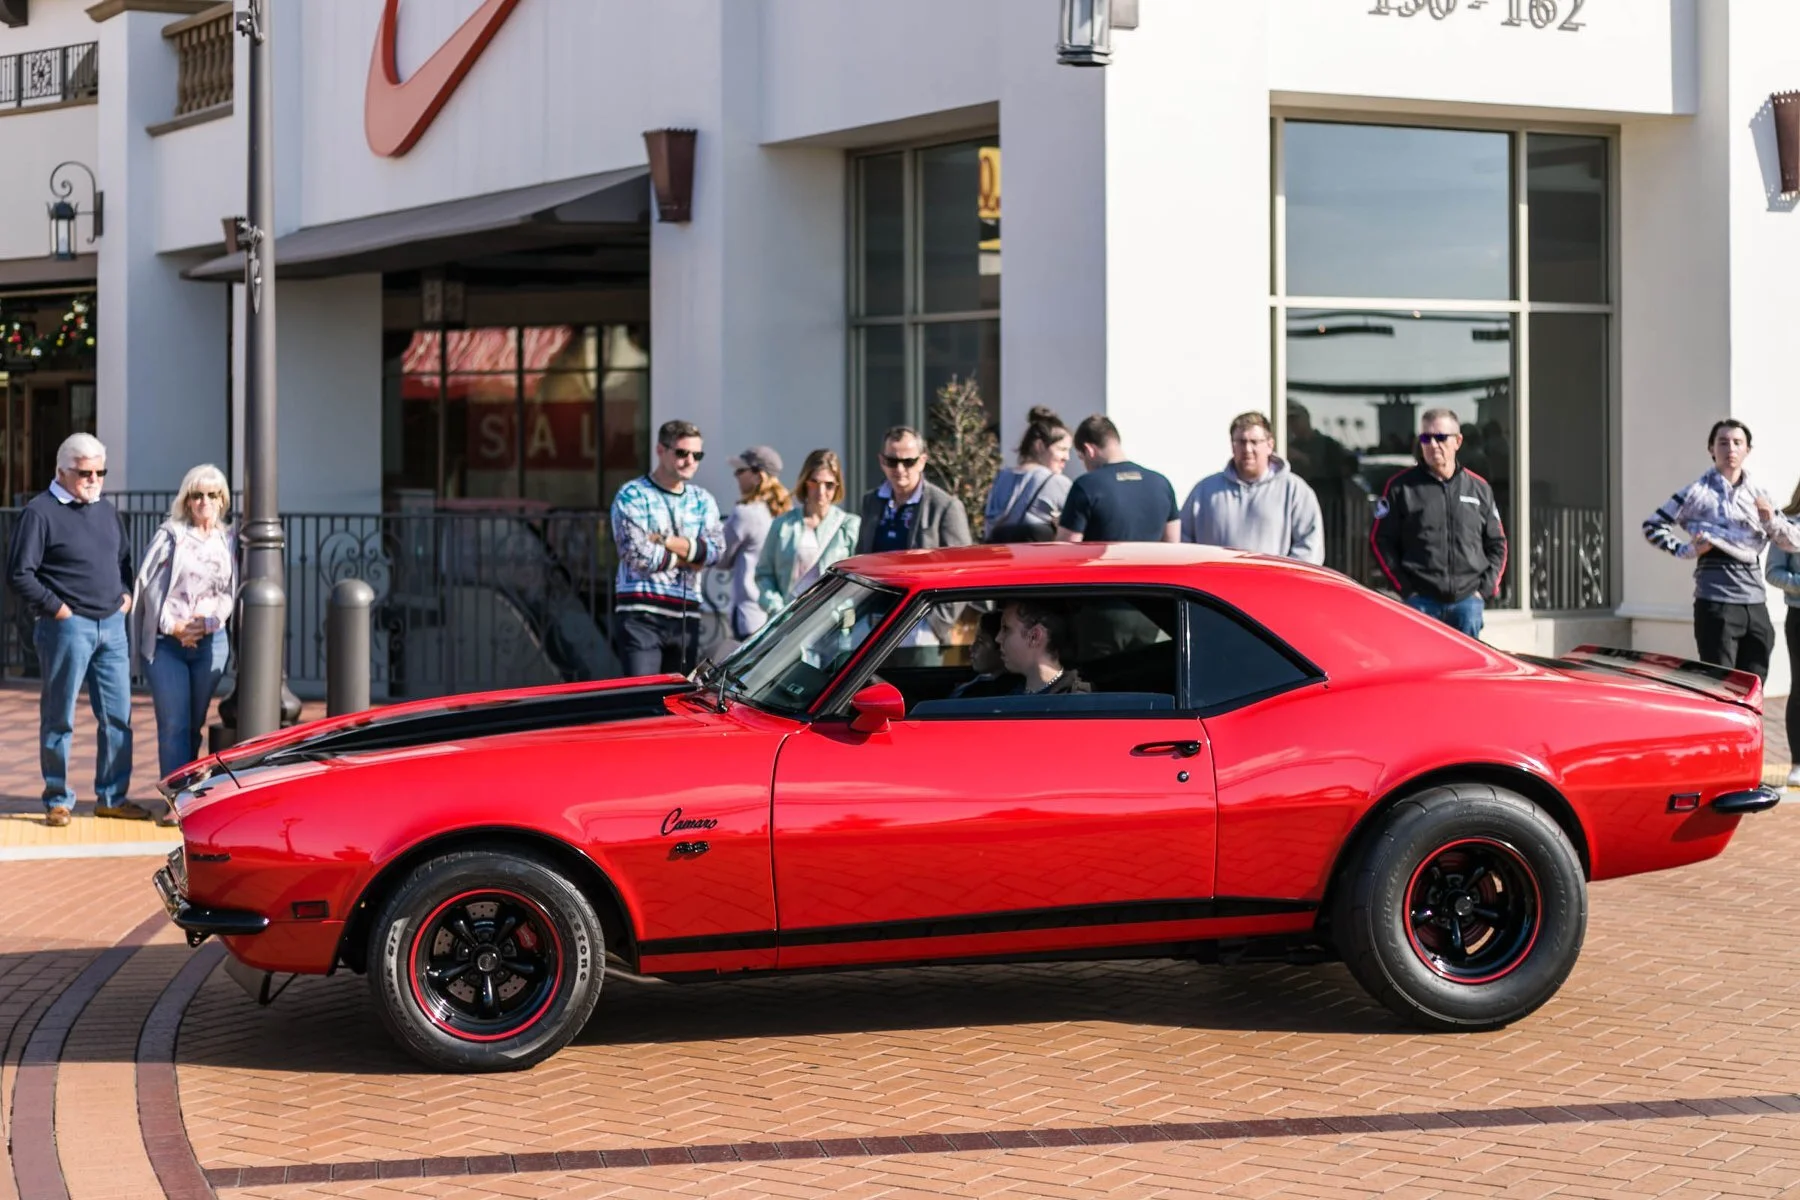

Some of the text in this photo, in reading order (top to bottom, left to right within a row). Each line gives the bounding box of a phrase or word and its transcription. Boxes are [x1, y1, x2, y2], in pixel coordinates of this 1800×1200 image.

[1500, 0, 1586, 31] 162
[480, 412, 640, 459] SAL
[661, 807, 718, 836] Camaro
